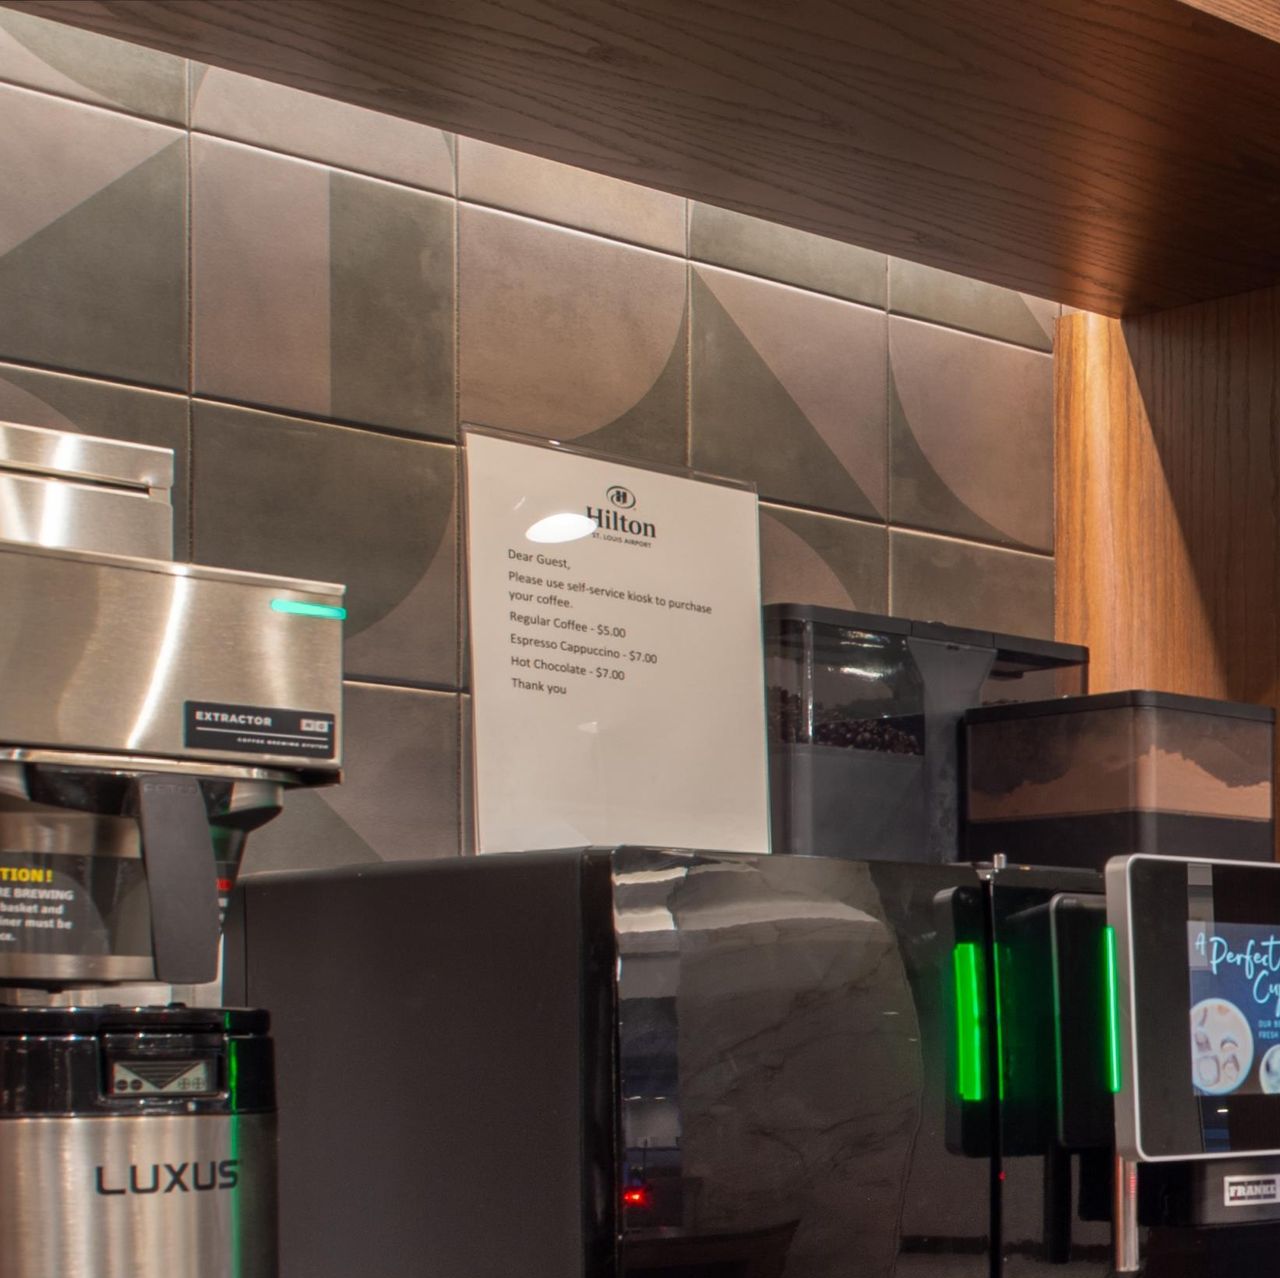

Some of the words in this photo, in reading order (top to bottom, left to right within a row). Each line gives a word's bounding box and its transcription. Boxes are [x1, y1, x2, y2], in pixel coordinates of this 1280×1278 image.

[586, 506, 656, 538] Hilton
[624, 537, 652, 549] AIRPORT
[508, 549, 533, 562] Dear
[536, 552, 571, 570] Guest,
[508, 571, 543, 586] Please
[546, 579, 564, 590] use
[567, 582, 625, 599] self-service
[627, 593, 654, 604] kiosk
[655, 596, 666, 607] to
[668, 599, 712, 614] purchase
[509, 590, 533, 604] your
[536, 594, 574, 609] coffee.
[510, 611, 550, 626] Regular
[553, 618, 588, 632] Coffee
[597, 624, 626, 638] $5.00
[510, 633, 557, 650] Espresso
[560, 640, 620, 659] Cappuccino
[629, 650, 658, 664] $7.00
[511, 656, 531, 668] Hot
[533, 659, 587, 675] Chocolate
[596, 667, 625, 680] $7.00
[511, 678, 544, 691] Thank
[547, 683, 567, 695] you
[195, 711, 272, 727] EXTRACTOR
[13, 888, 74, 901] BREWING
[0, 902, 38, 914] basket
[41, 904, 65, 915] and
[24, 918, 54, 929] must
[57, 917, 73, 929] be
[95, 1159, 240, 1195] LUXUS
[1229, 1184, 1276, 1198] FRANKE
